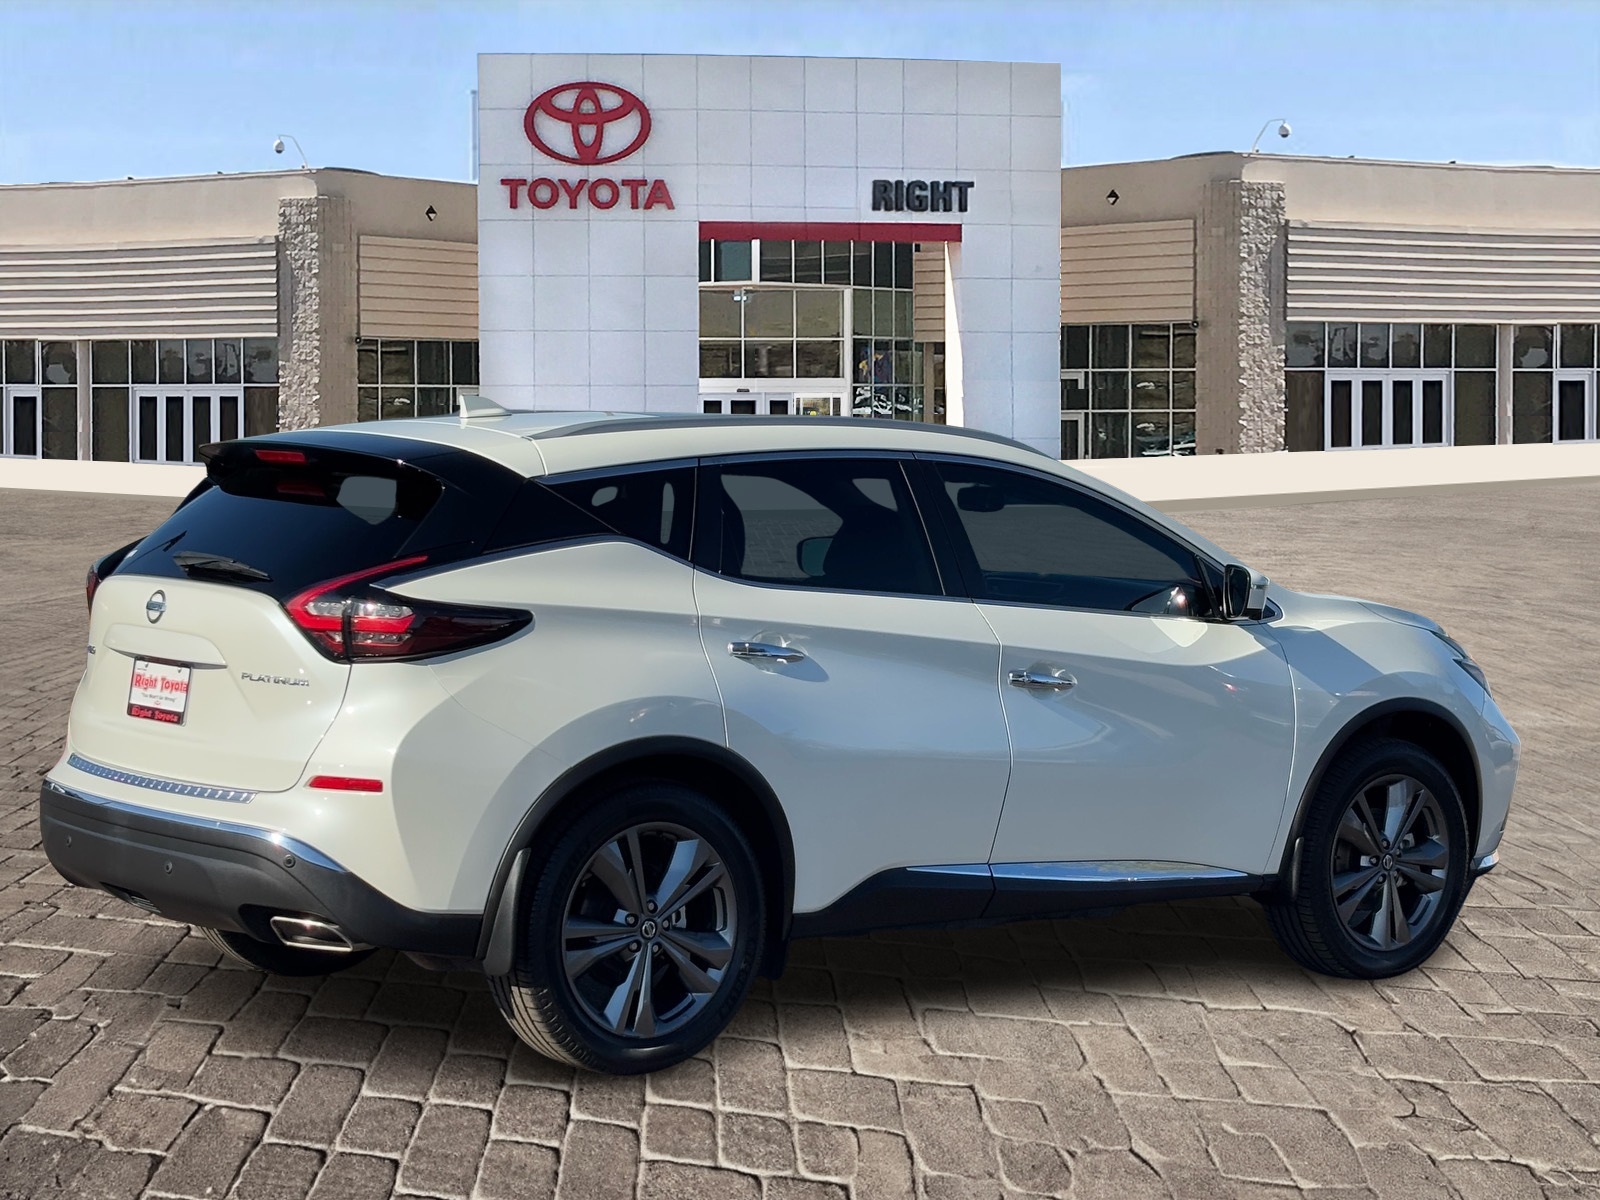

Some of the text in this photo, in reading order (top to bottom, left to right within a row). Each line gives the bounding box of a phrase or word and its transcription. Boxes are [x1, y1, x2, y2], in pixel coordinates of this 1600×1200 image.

[500, 178, 675, 210] TOYOTA
[872, 179, 974, 212] RIGHT
[134, 673, 188, 694] Right Toyota
[241, 672, 310, 686] PLATINUM
